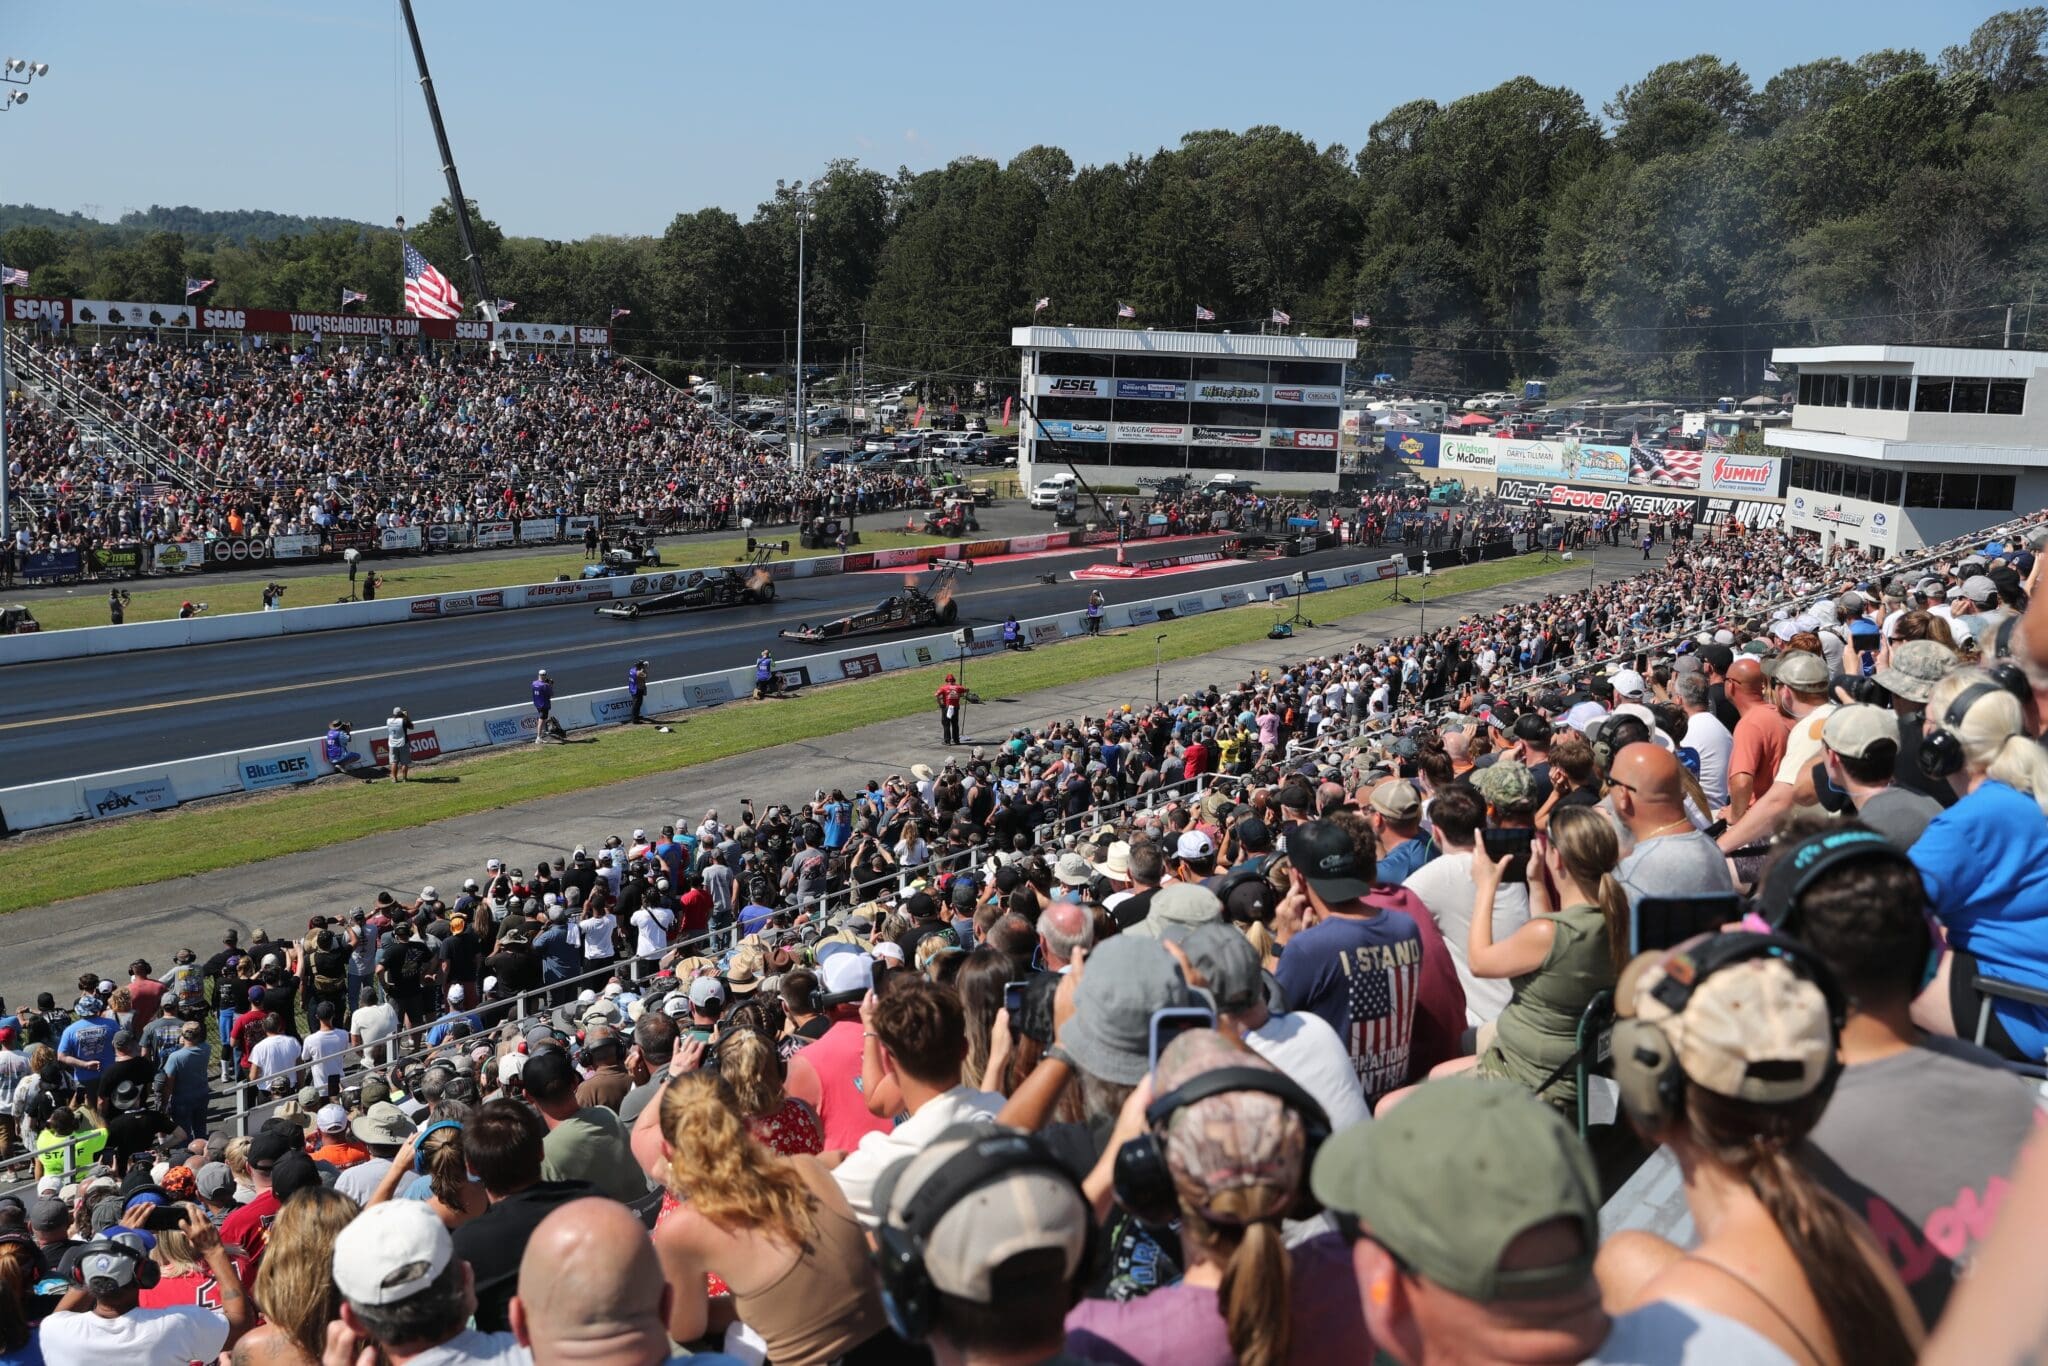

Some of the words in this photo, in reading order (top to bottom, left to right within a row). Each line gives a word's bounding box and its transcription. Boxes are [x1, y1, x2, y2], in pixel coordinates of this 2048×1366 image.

[14, 299, 65, 320] SCAG
[203, 310, 246, 329] SCAG
[455, 322, 488, 340] SCAG
[579, 328, 608, 343] SCAG
[1050, 379, 1098, 391] JESEL
[1117, 425, 1151, 433] INSINGER
[1297, 432, 1334, 447] SCAG
[1456, 443, 1489, 455] Watson
[1456, 453, 1496, 465] McDaniel
[1506, 450, 1526, 459] DARYL
[1527, 451, 1554, 461] TILLMAN
[1500, 481, 1553, 505] Maple
[1552, 486, 1608, 509] Grove
[385, 533, 408, 543] United
[1178, 552, 1218, 566] NATIONALS
[1088, 566, 1119, 574] LUCAS
[538, 583, 582, 596] Bergey's
[477, 594, 499, 603] Arnold's
[412, 600, 436, 610] Arnold's
[489, 719, 515, 730] CAMPING
[492, 726, 518, 737] WORLD
[246, 756, 306, 779] BlueDEF
[96, 794, 139, 815] PEAK
[1340, 950, 1350, 976] I
[1356, 938, 1420, 972] STAND
